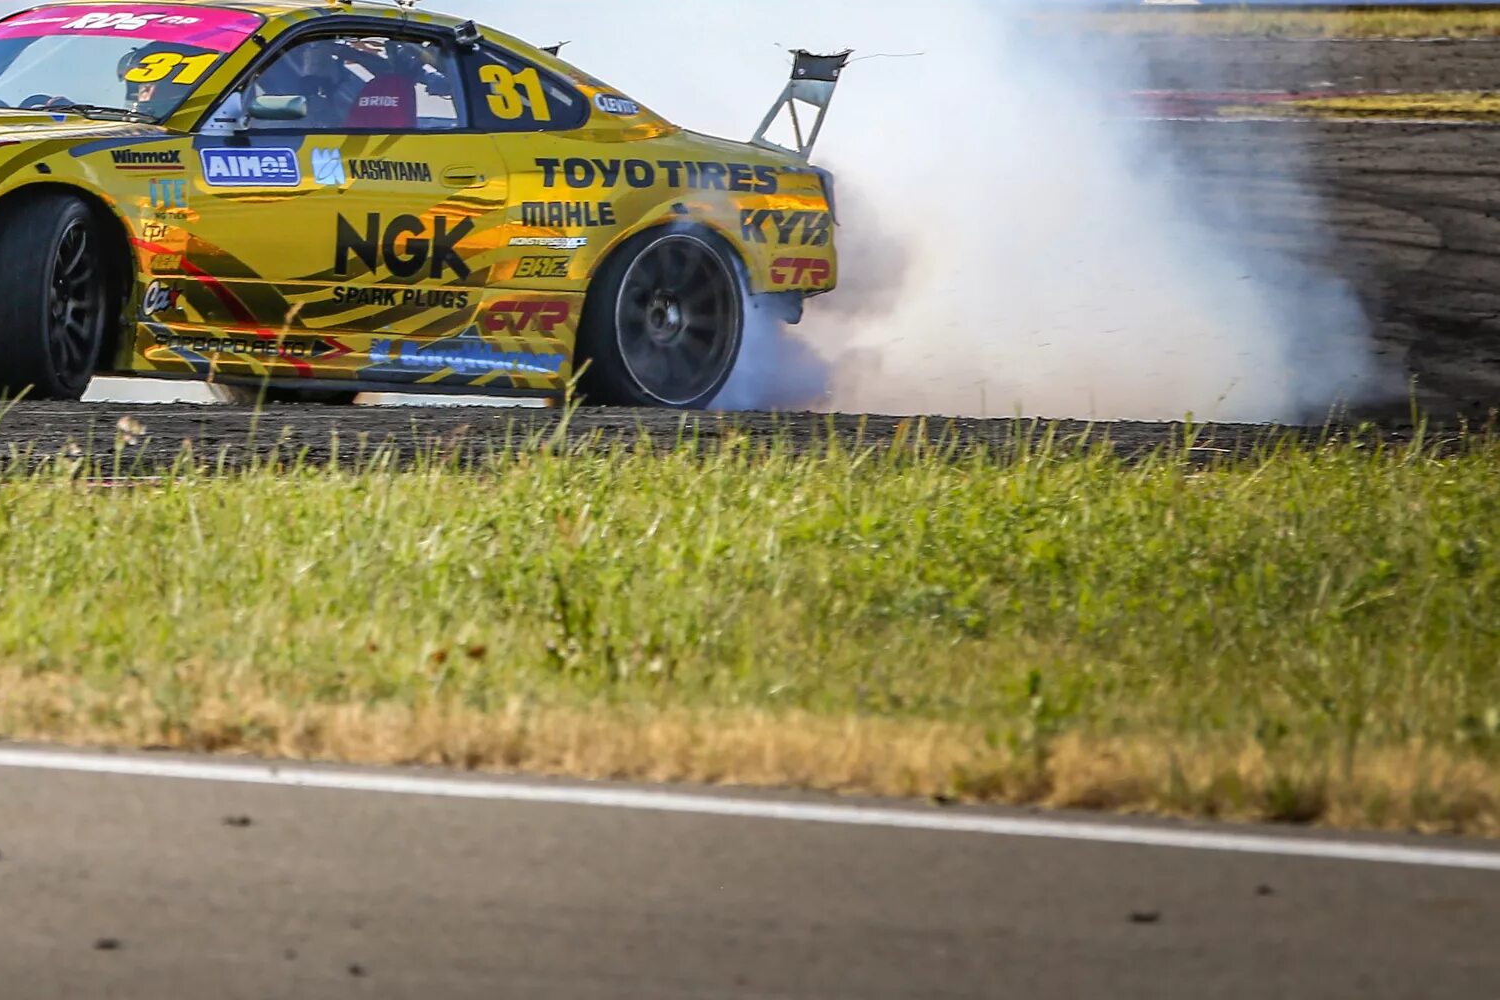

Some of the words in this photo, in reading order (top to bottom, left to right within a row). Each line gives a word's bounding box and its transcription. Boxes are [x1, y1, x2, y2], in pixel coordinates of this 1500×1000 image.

[60, 12, 167, 31] RDS
[124, 52, 220, 84] 31
[358, 96, 399, 107] BRIDE
[478, 64, 551, 122] 31
[209, 155, 296, 178] AIMOL
[348, 158, 433, 182] KASHIYAMA
[535, 158, 655, 188] TOYO
[656, 160, 778, 195] TIRES
[522, 201, 617, 227] MAHLE
[740, 209, 829, 245] KYB
[333, 211, 476, 281] NGK
[770, 257, 830, 286] CTR
[332, 286, 397, 306] SPARK
[402, 289, 469, 309] PLUGS
[484, 301, 569, 331] CTR
